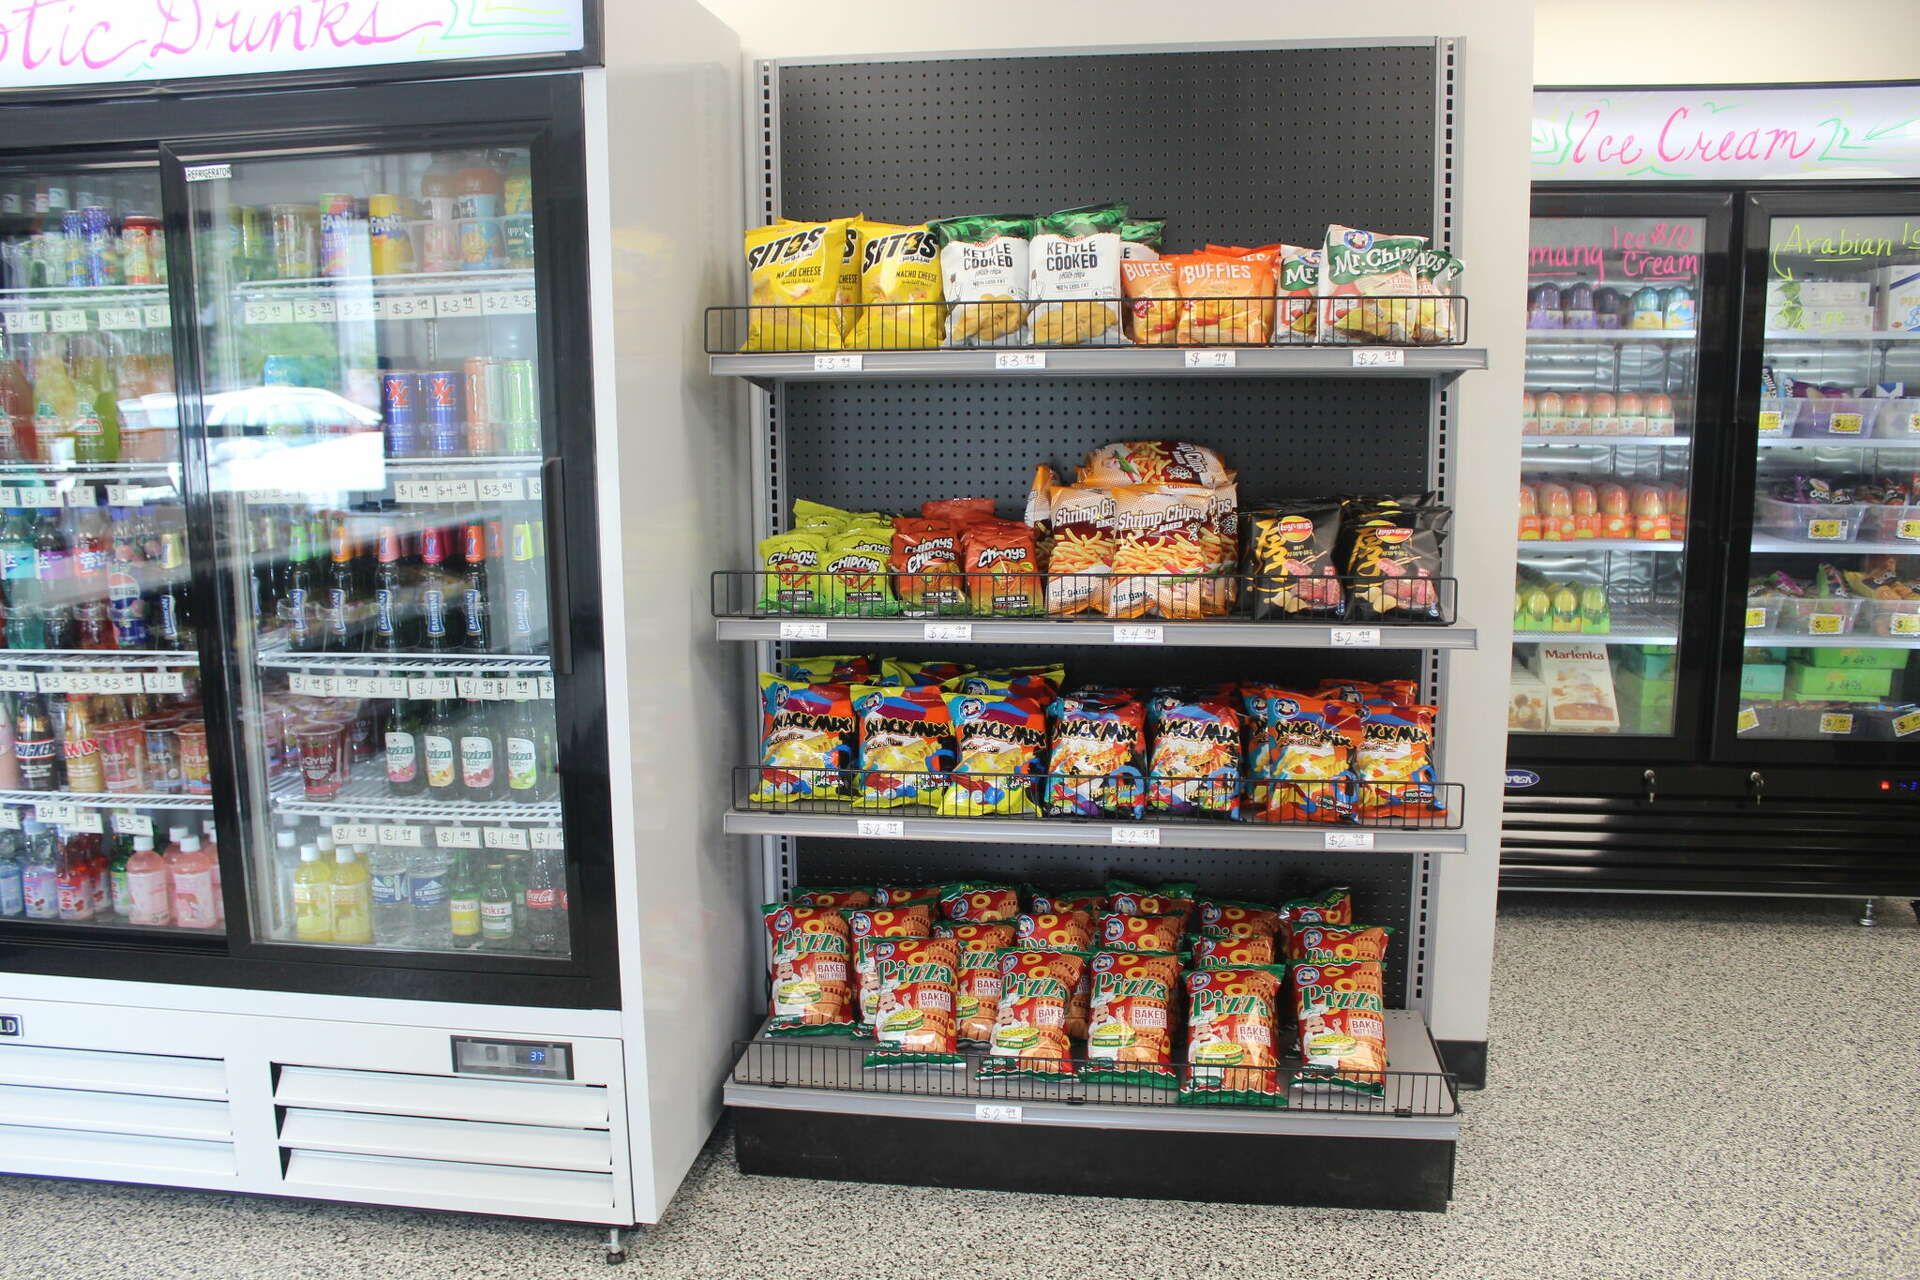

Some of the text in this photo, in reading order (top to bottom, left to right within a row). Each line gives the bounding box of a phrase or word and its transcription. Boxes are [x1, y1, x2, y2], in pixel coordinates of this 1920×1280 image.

[1572, 106, 1817, 164] Ice Cream
[1046, 240, 1096, 256] KETTLE
[1780, 224, 1892, 256] Arabian
[963, 243, 1012, 258] KETTLE
[798, 266, 822, 277] CHEESE
[963, 254, 1013, 271] COOKED
[1046, 254, 1098, 271] COOKED
[1123, 262, 1177, 281] BUFFIE
[1624, 250, 1697, 277] Cream
[1184, 263, 1252, 284] BUFFIES
[1055, 504, 1097, 527] Shrimp
[1118, 511, 1162, 531] Shrimp
[1165, 504, 1201, 522] Chips
[827, 555, 880, 573] CHIPOYS
[1545, 649, 1605, 661] Marlenka
[910, 720, 949, 738] MIX
[962, 721, 1047, 748] SNACK MIX
[1101, 720, 1139, 743] MIX
[1275, 720, 1320, 742] SNACK
[1394, 725, 1431, 744] MIX
[777, 927, 845, 956] Pizza
[817, 963, 846, 974] BAKED
[879, 959, 952, 985] Pizza
[977, 979, 1000, 989] BAKE
[1001, 972, 1068, 999] Pizza
[1094, 972, 1168, 1000] Pizza
[921, 992, 950, 1003] BAKED
[1191, 988, 1268, 1018] Pizza
[1301, 984, 1384, 1012] Pizza
[1135, 1009, 1167, 1020] BAKED
[1352, 1020, 1382, 1032] BAKED
